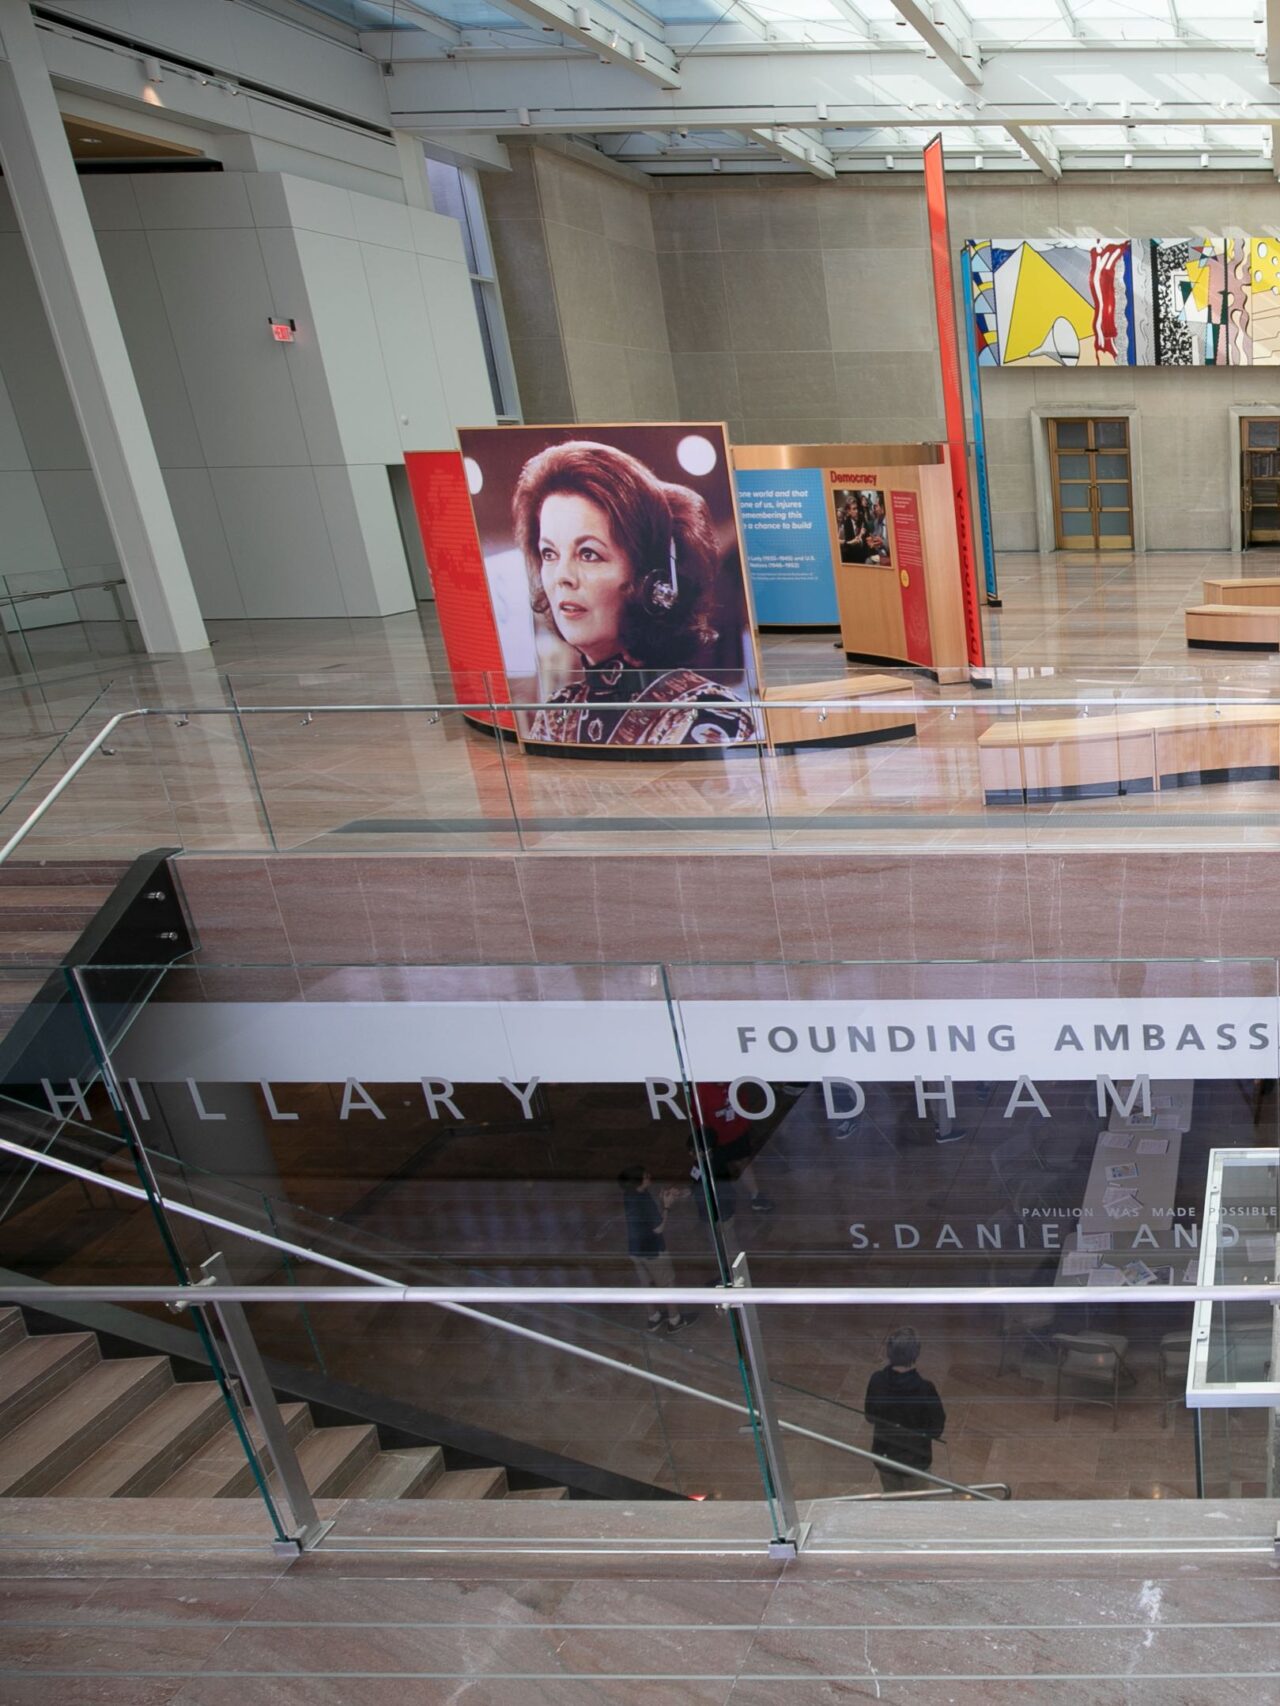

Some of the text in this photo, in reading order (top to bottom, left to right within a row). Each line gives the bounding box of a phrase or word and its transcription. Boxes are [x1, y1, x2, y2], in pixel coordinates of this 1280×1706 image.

[830, 470, 877, 486] Democracy
[754, 500, 763, 508] of
[776, 500, 802, 509] injures
[788, 511, 803, 519] this
[737, 1024, 1016, 1053] FOUNDING
[40, 1075, 540, 1121] HILLARY
[645, 1072, 1153, 1121] RODHAM
[1022, 1207, 1094, 1217] PAVILION
[1106, 1206, 1140, 1218] WAS
[1152, 1207, 1196, 1217] MADE
[1209, 1206, 1278, 1217] POSSIBLE
[1131, 1223, 1240, 1248] AND
